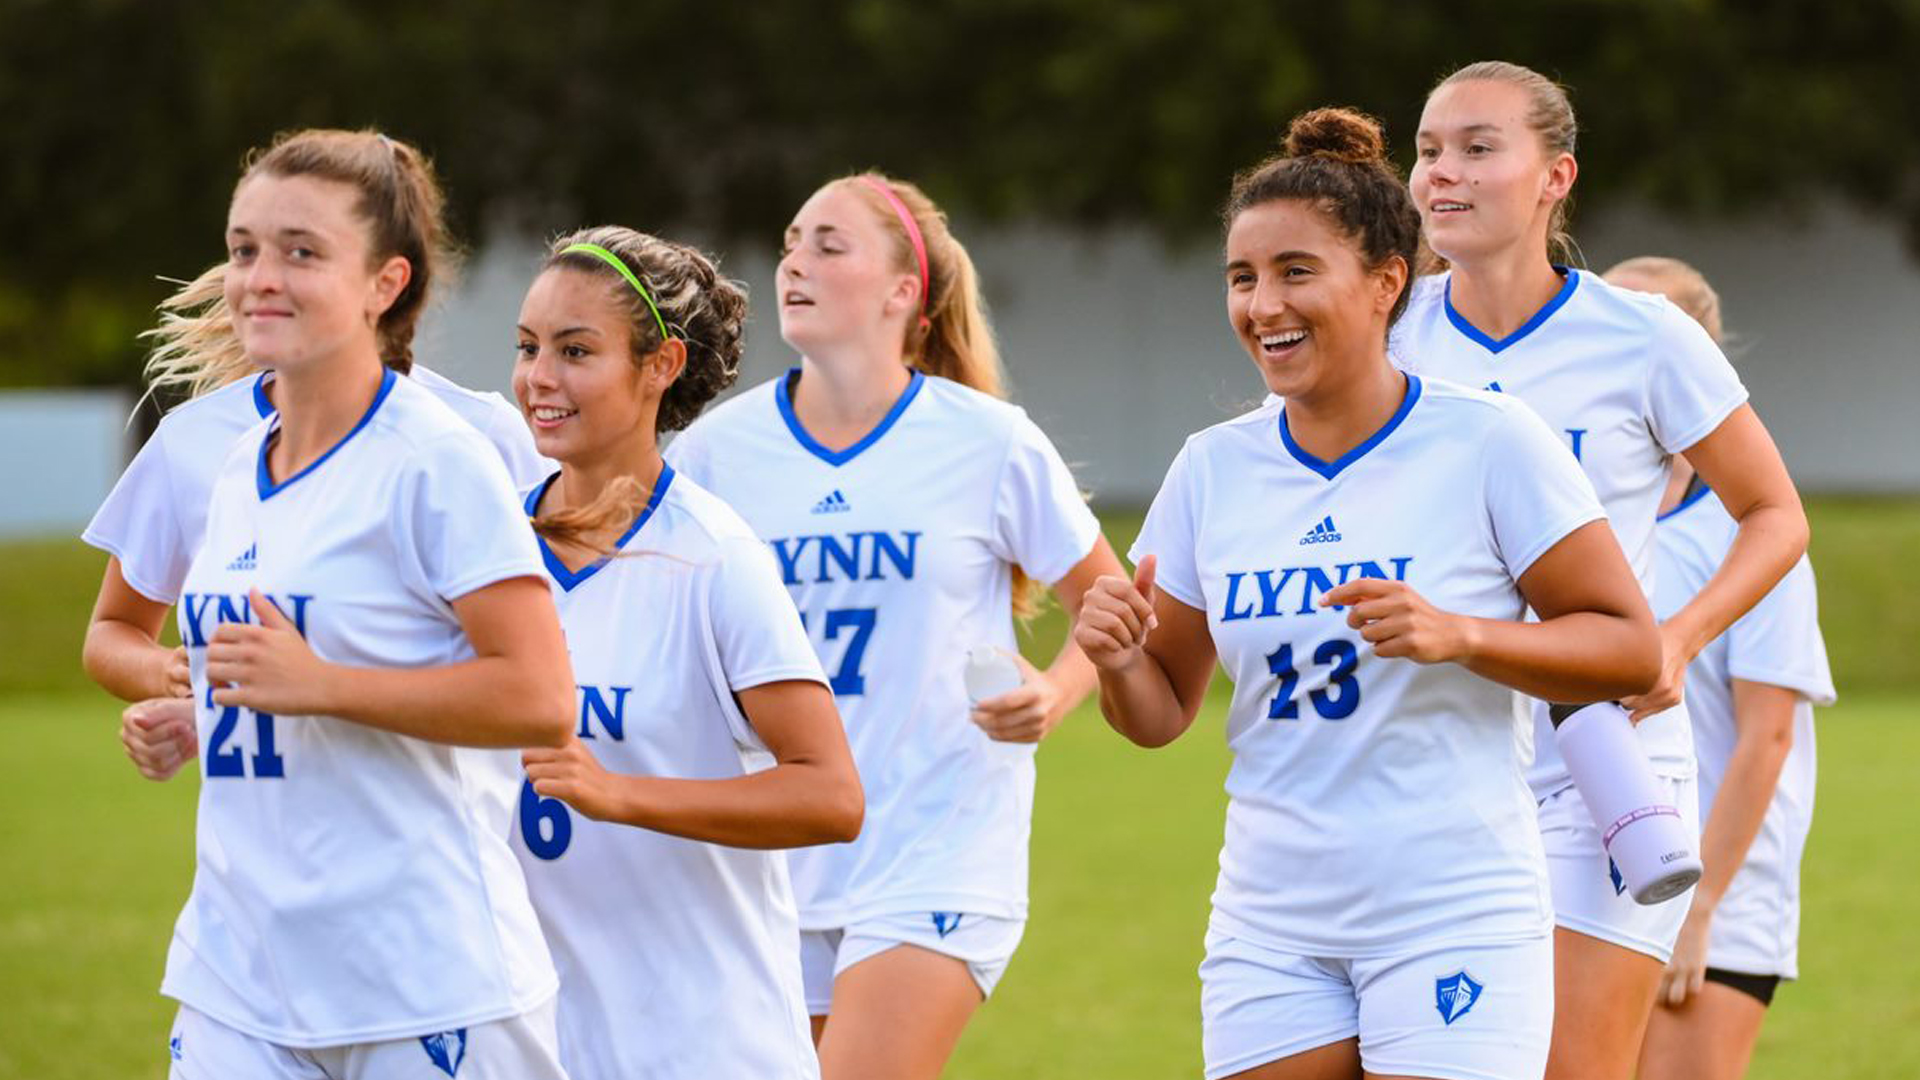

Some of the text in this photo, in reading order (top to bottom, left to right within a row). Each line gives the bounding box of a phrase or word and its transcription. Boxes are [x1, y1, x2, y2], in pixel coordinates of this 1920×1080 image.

[762, 530, 923, 585] YNN
[1299, 532, 1342, 546] adidas
[183, 593, 315, 648] YN
[800, 607, 877, 696] 7
[1266, 639, 1360, 720] 13
